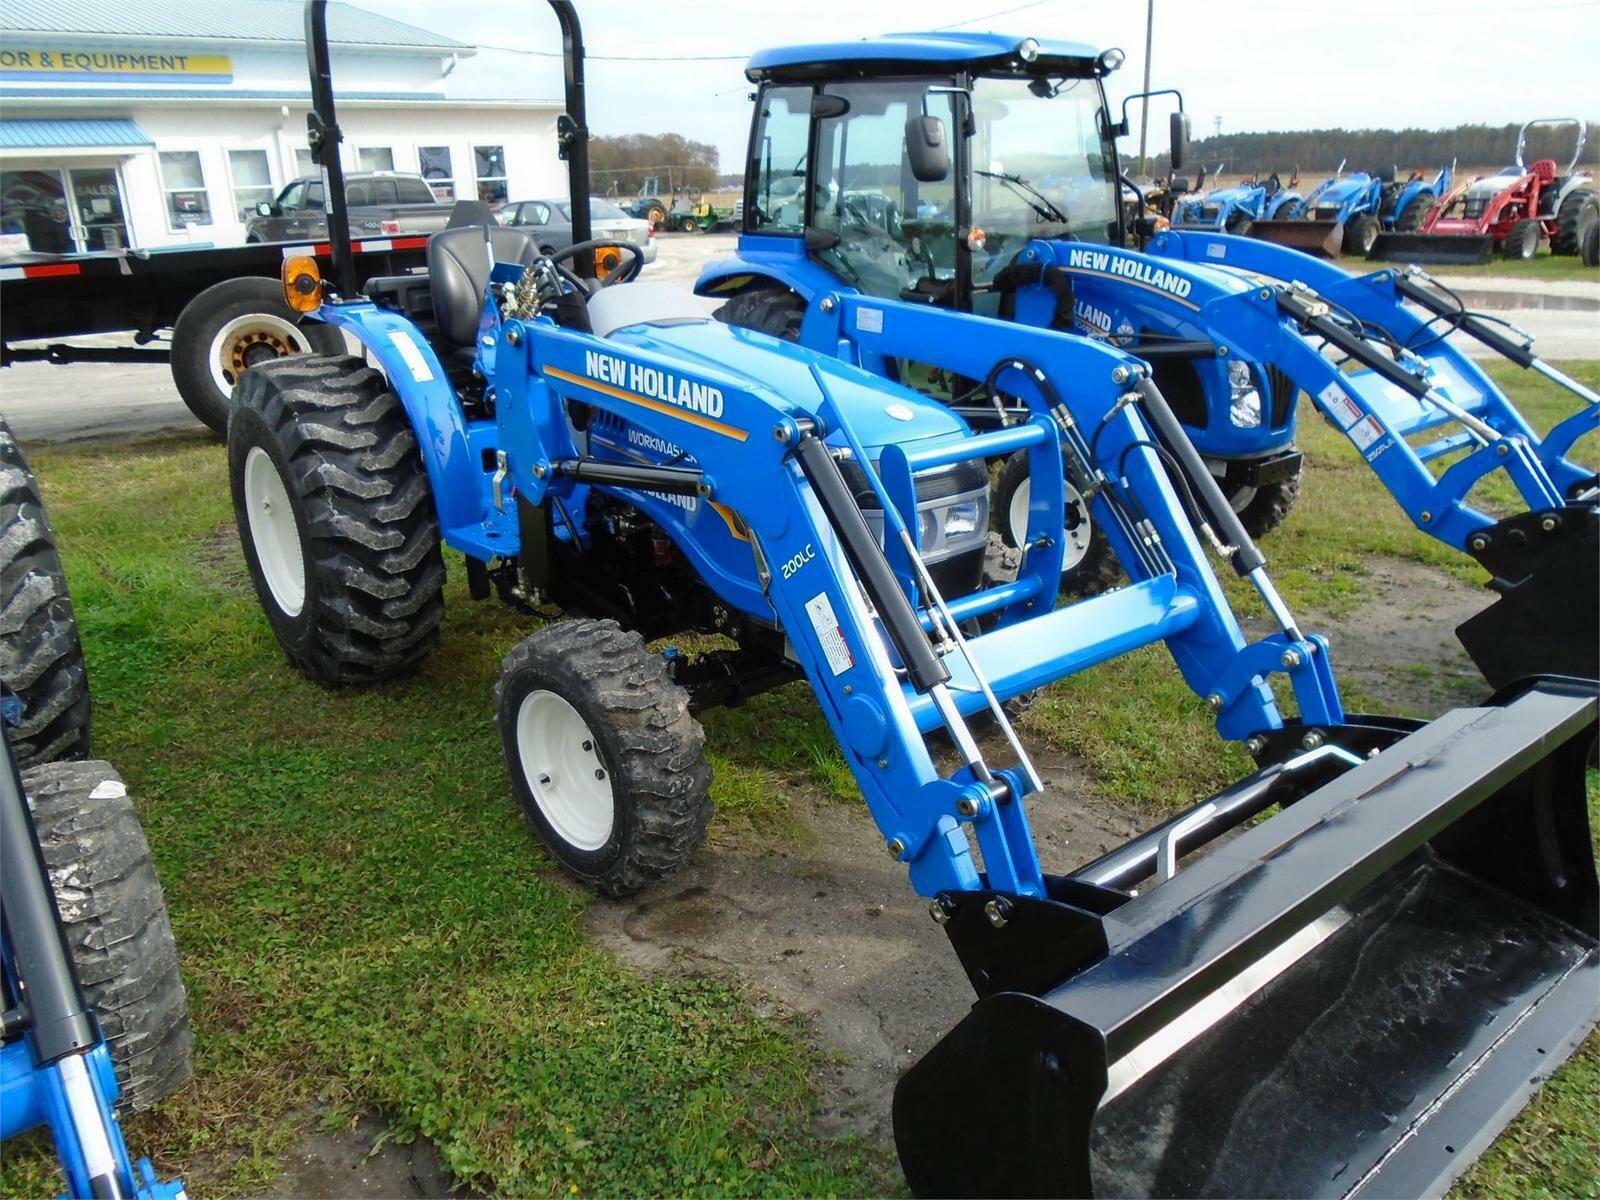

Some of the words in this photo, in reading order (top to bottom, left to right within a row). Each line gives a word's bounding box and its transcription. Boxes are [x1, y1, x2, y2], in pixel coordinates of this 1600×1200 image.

[0, 51, 32, 67] OR
[39, 52, 54, 68] &
[60, 52, 188, 71] EQUIPMENT
[1070, 249, 1109, 271] NEW
[1111, 256, 1192, 298] HOLLAND
[1073, 300, 1112, 332] LAND
[585, 350, 626, 386] NEW
[630, 363, 723, 418] HOLLAND
[628, 429, 698, 464] WORKMASR
[781, 543, 816, 580] 200LC
